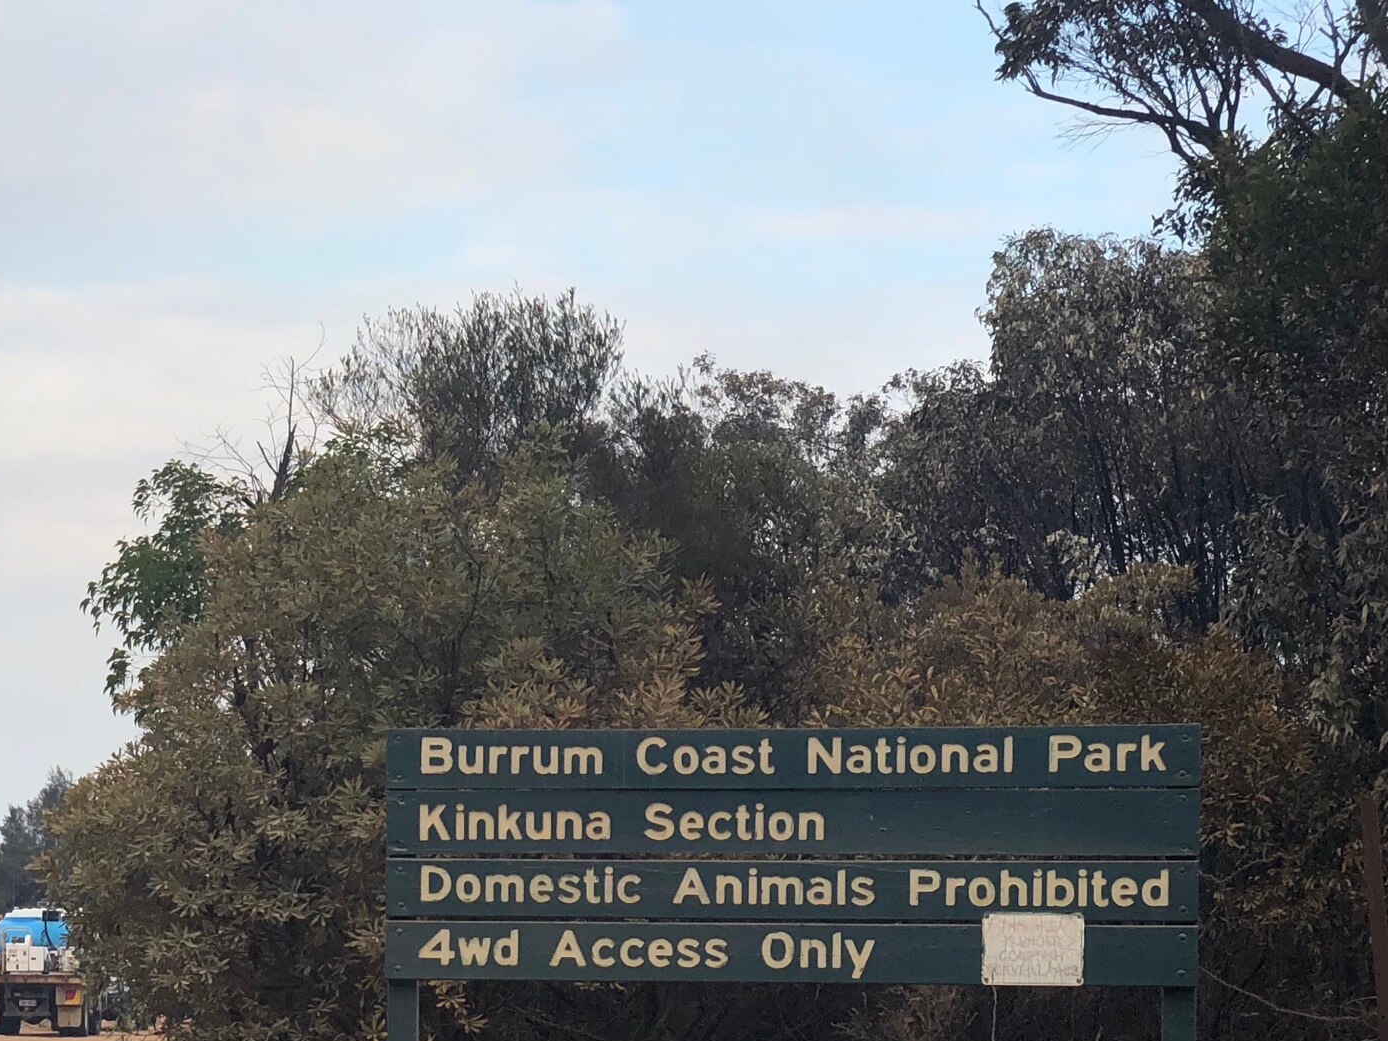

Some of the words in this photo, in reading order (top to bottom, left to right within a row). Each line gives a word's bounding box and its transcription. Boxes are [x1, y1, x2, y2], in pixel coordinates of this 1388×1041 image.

[420, 737, 603, 775] Burrum
[636, 736, 774, 775] Coast
[807, 736, 1013, 774] National
[1049, 735, 1166, 773] Park
[419, 804, 611, 841] Kinkuna
[644, 803, 825, 841] Section
[420, 865, 641, 904] Domestic
[673, 867, 875, 906] Animals
[909, 869, 1169, 908] Prohibited
[418, 928, 519, 966] 4wd
[549, 929, 728, 968] Access
[761, 931, 875, 979] Only
